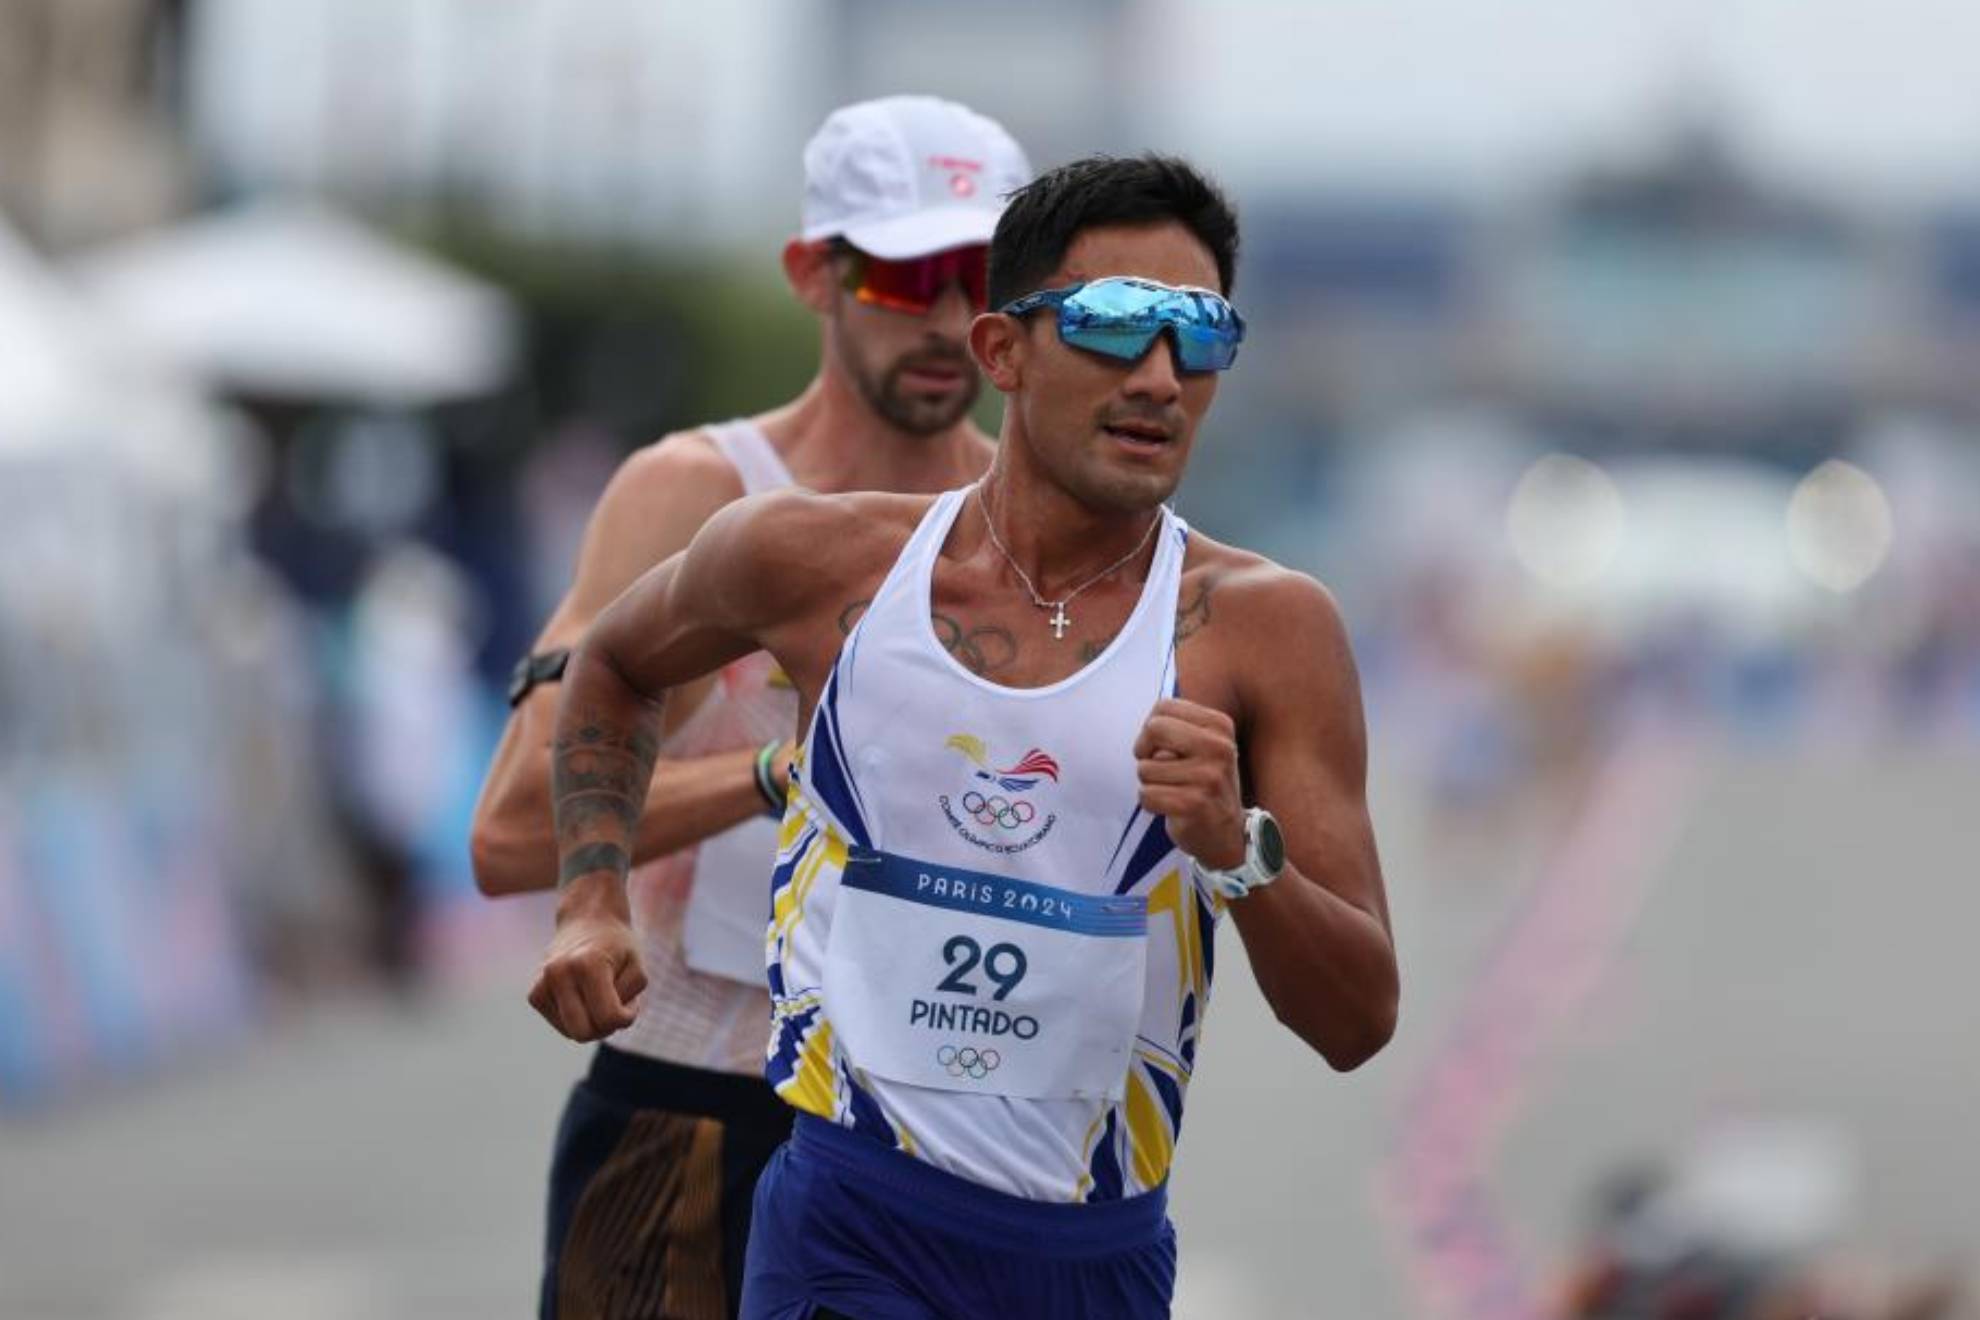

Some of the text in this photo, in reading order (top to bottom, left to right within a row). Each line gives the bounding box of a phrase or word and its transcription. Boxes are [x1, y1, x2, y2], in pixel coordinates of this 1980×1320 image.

[917, 873, 1072, 921] PARIS 2024
[936, 934, 1027, 1002] 29
[910, 999, 1039, 1040] PINTADO
